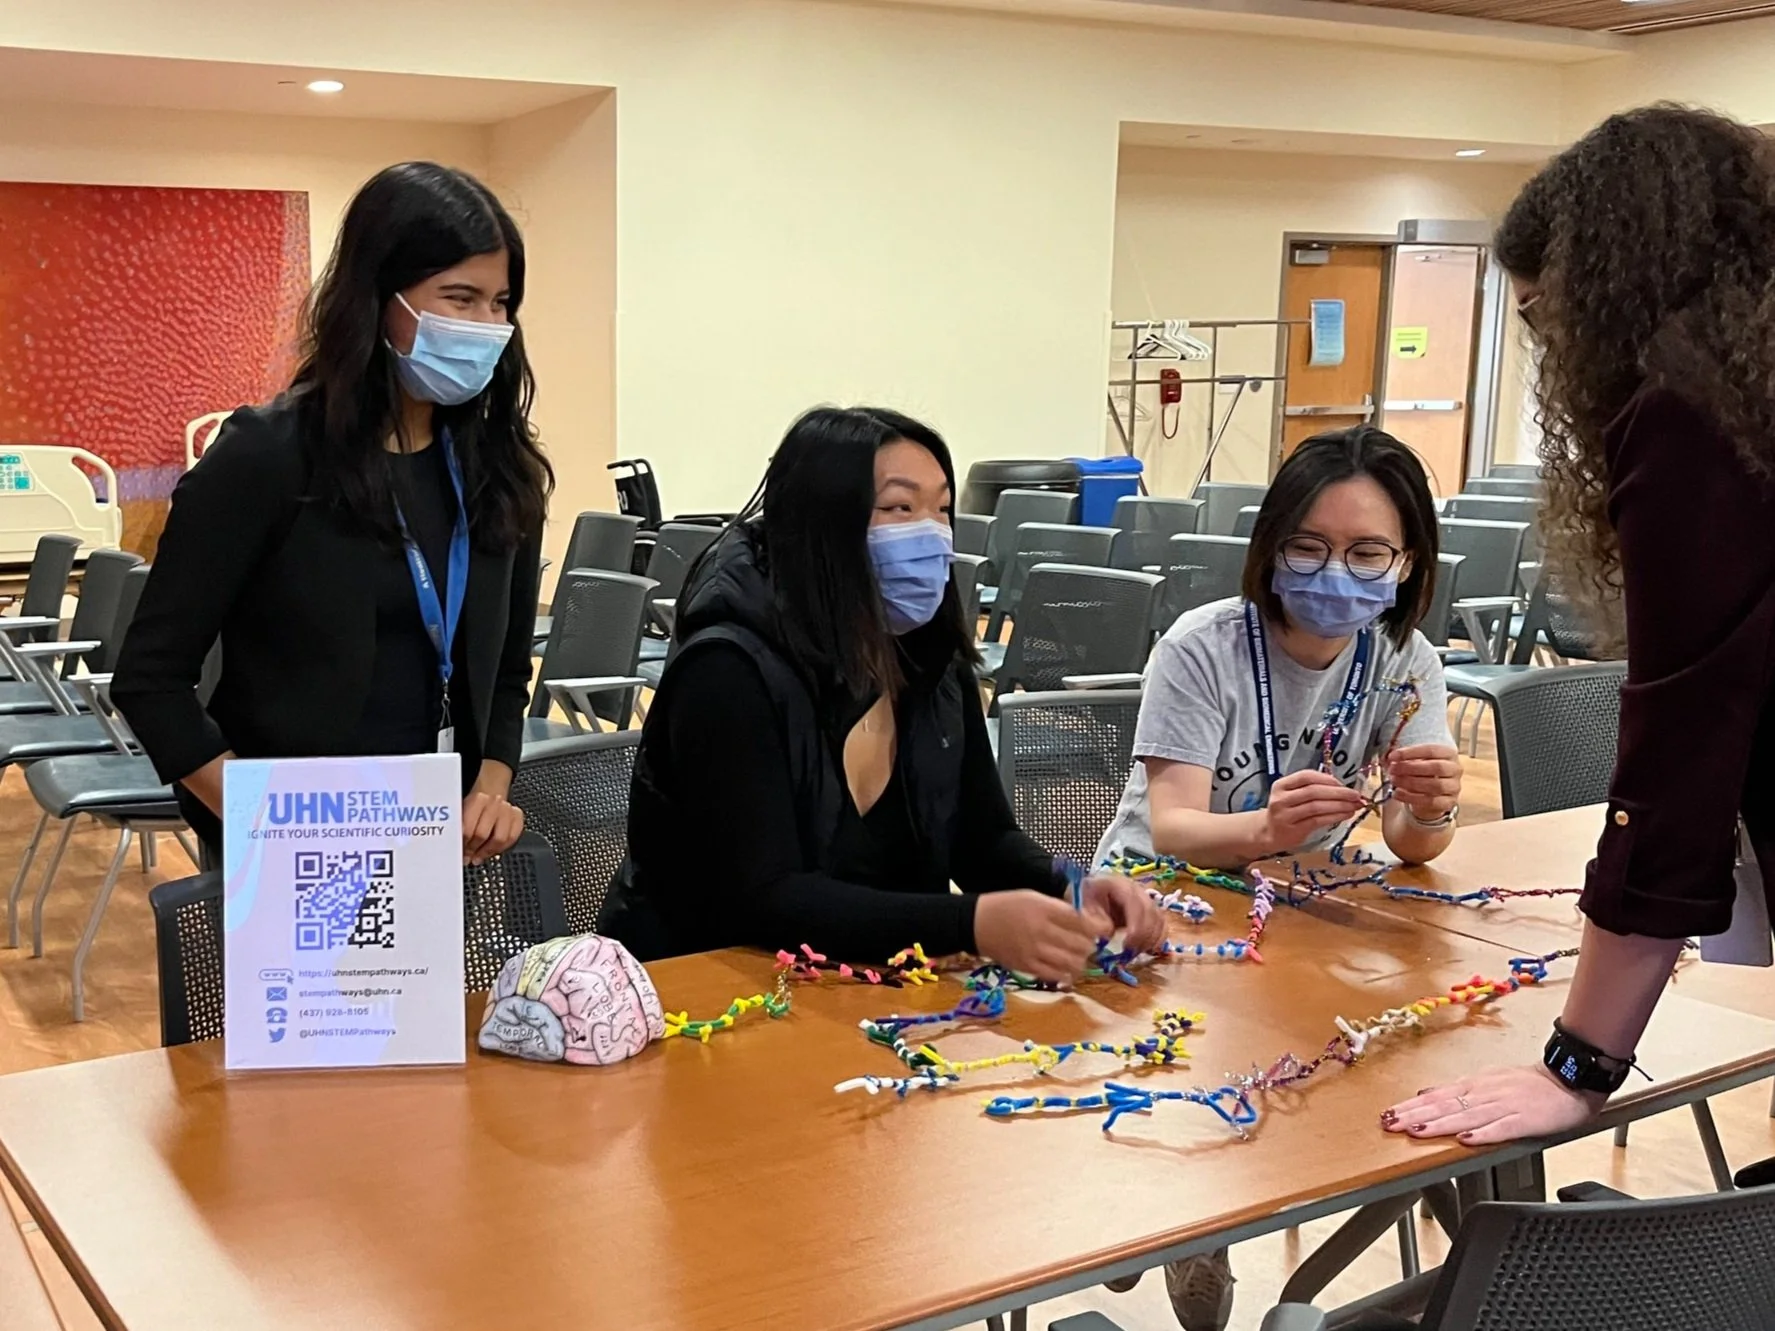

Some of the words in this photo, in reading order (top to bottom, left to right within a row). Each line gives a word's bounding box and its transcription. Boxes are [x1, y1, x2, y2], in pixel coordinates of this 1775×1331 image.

[1349, 662, 1363, 690] TORONTO
[347, 790, 398, 806] STEM
[268, 792, 345, 825] UHN
[347, 806, 450, 823] PATHWAYS
[287, 828, 319, 838] YOUR
[321, 827, 382, 838] SCIENTIFIC
[384, 826, 445, 836] CURIOSITY
[299, 967, 429, 978] https://uhnstempathways.ca/
[299, 988, 402, 998] stempathways@uhn.ca
[299, 1008, 324, 1018] (437)
[299, 1028, 397, 1039] @UHNSTEMPathways
